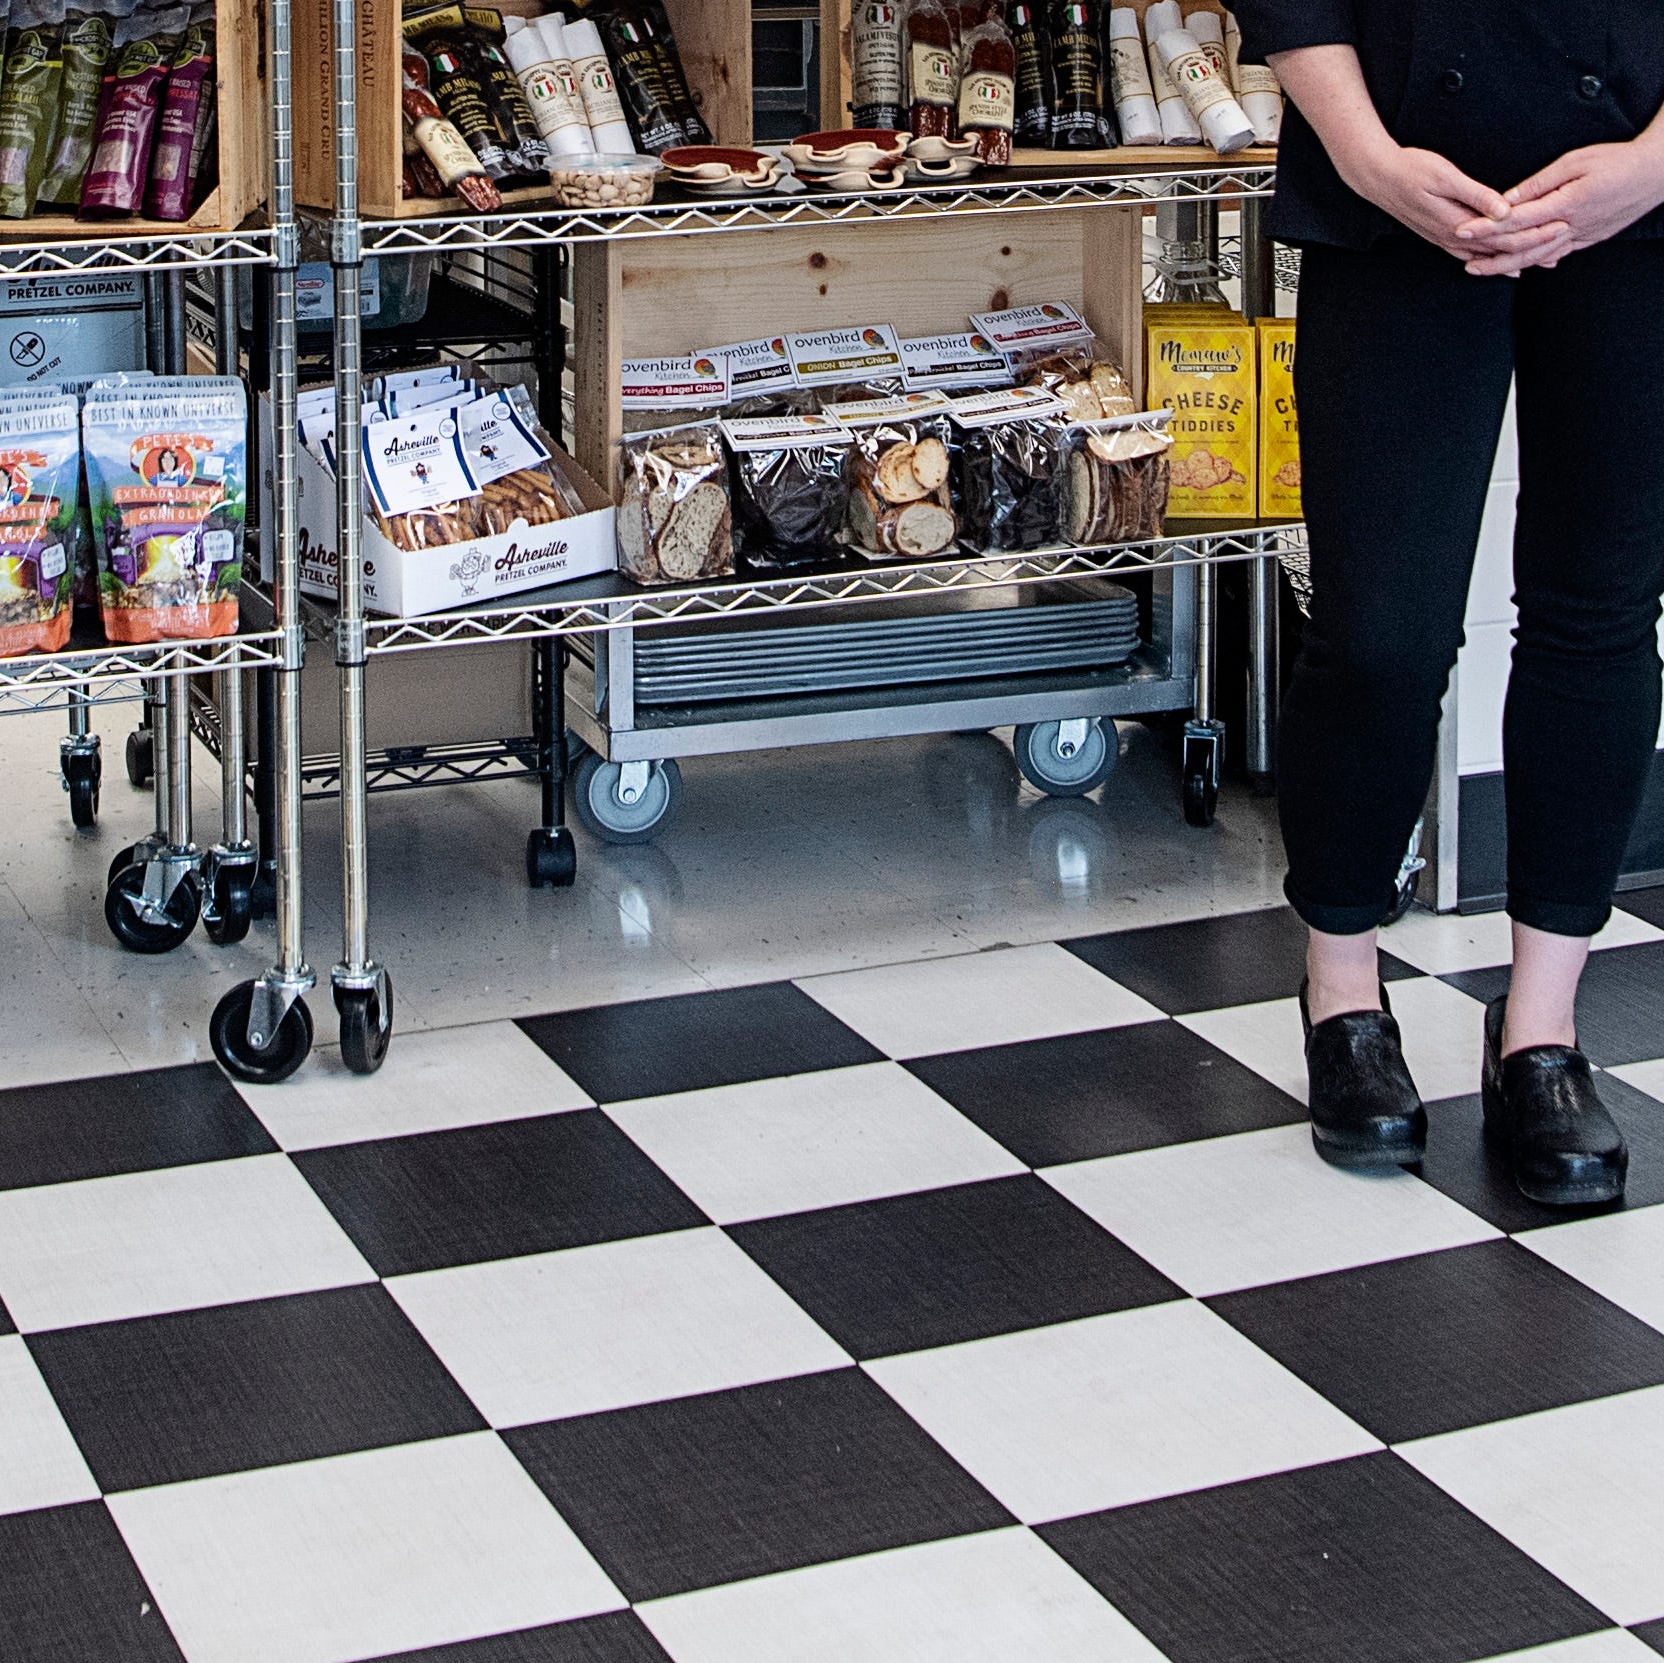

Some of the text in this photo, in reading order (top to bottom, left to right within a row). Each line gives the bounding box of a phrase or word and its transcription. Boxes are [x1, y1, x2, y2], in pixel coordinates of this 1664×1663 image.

[7, 286, 62, 300] PRETZEL
[795, 330, 861, 348] ovenbird
[807, 354, 892, 372] ONION Bagel Chips
[1162, 391, 1244, 416] CHEESE
[15, 412, 68, 430] UNIVERSE
[1171, 420, 1236, 433] TIDDIES
[495, 540, 569, 572] Asheville
[495, 567, 526, 583] PRETZEL
